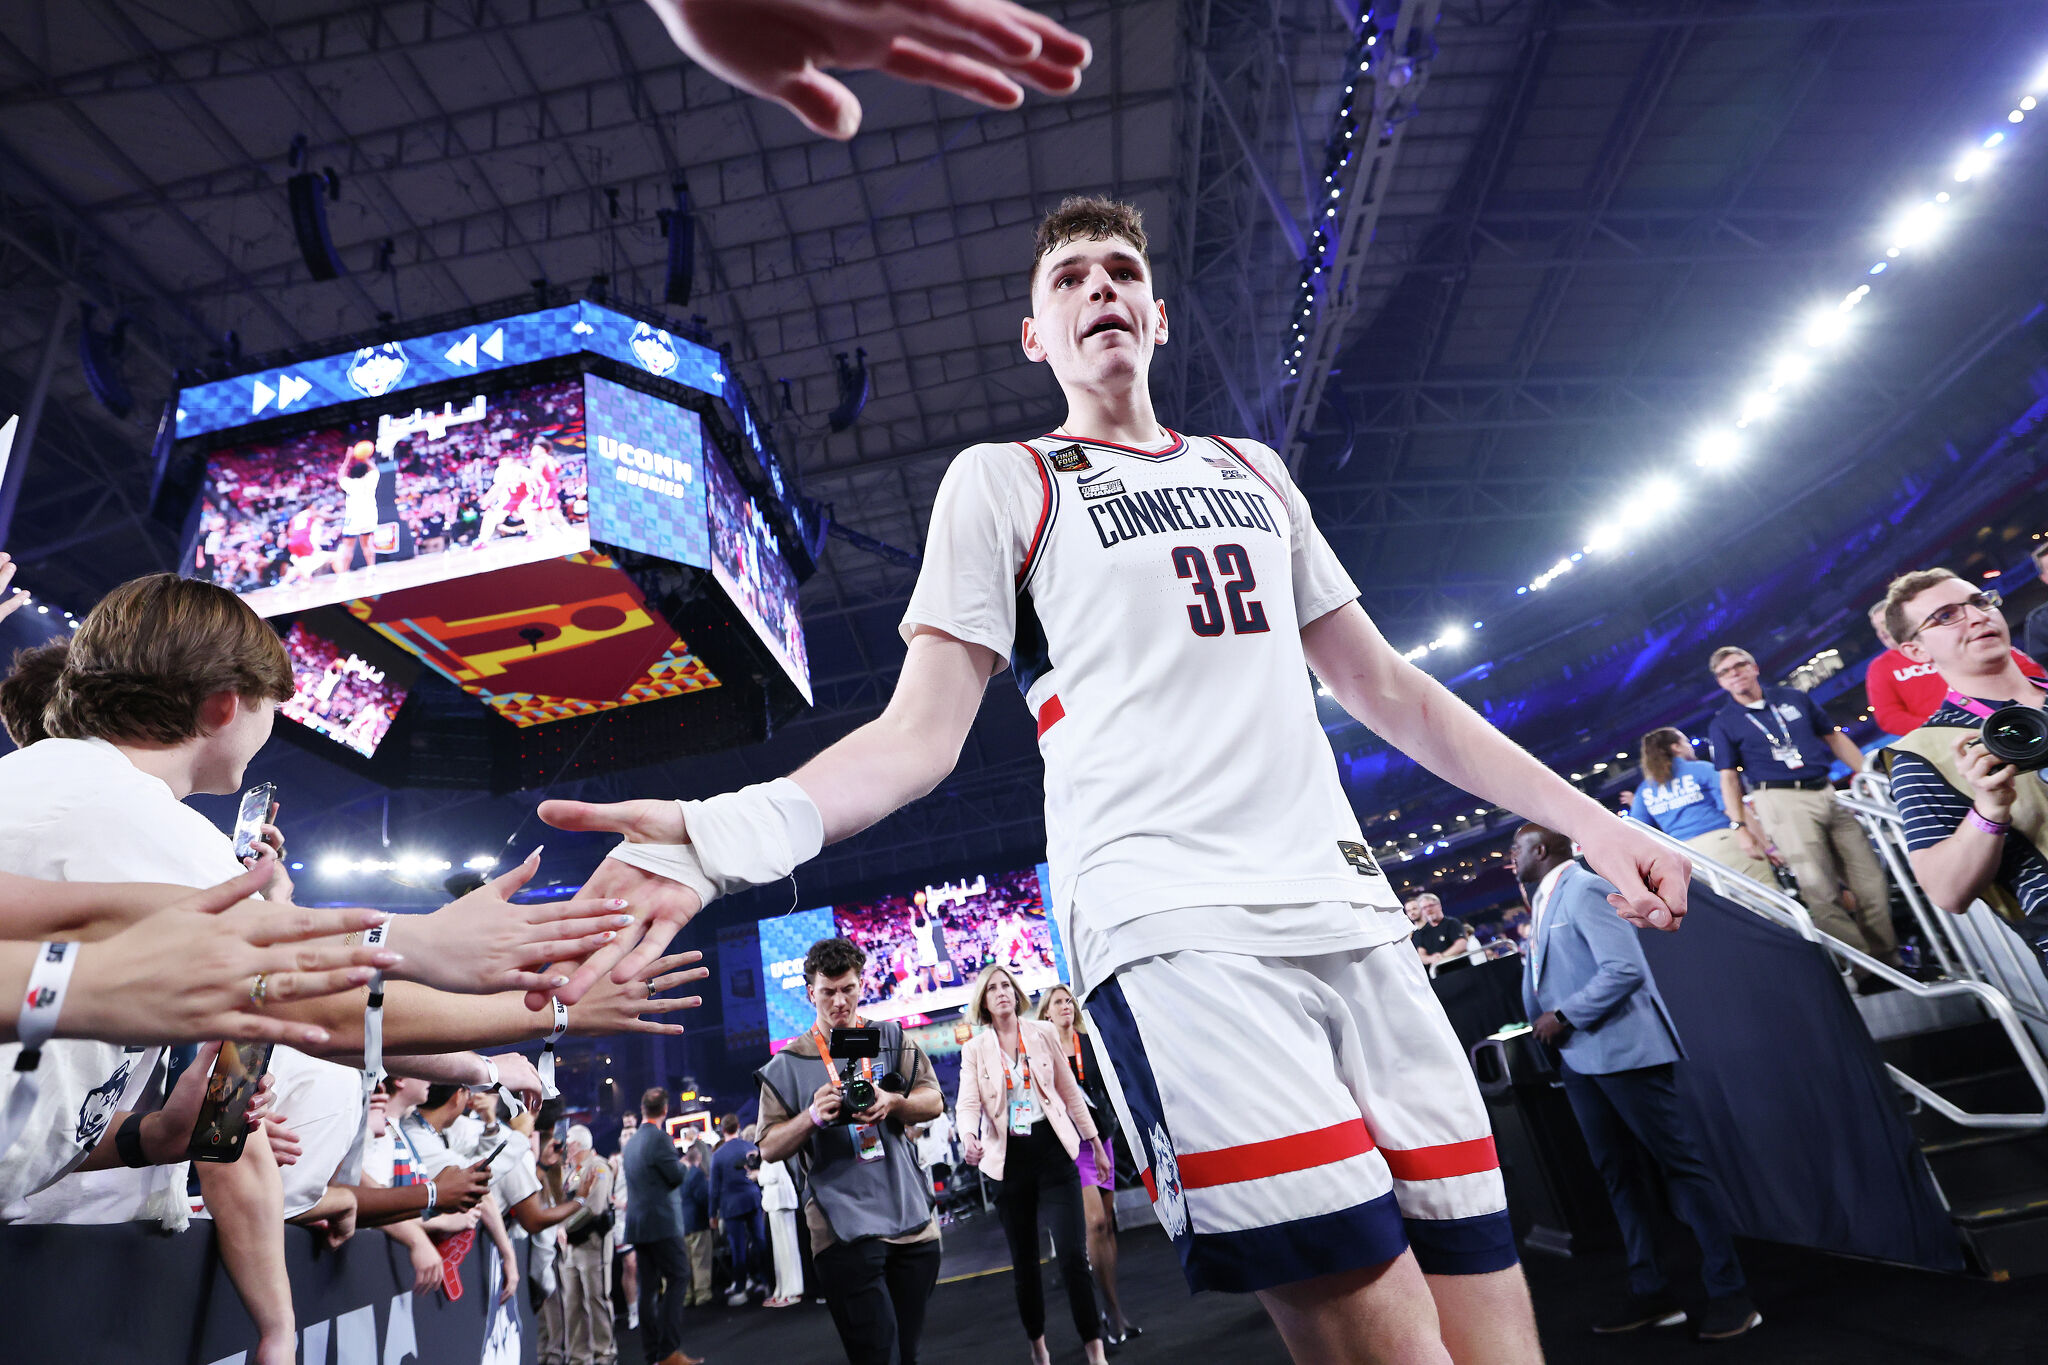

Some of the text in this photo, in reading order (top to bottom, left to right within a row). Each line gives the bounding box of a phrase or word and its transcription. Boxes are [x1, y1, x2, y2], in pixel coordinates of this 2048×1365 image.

[597, 434, 692, 484] UCONN
[1056, 449, 1077, 461] FINAL
[1058, 455, 1079, 466] FOUR
[1087, 486, 1282, 549] CONNECTICUT
[1171, 543, 1271, 637] 32
[1892, 663, 1938, 681] UCO
[770, 956, 807, 978] UCO
